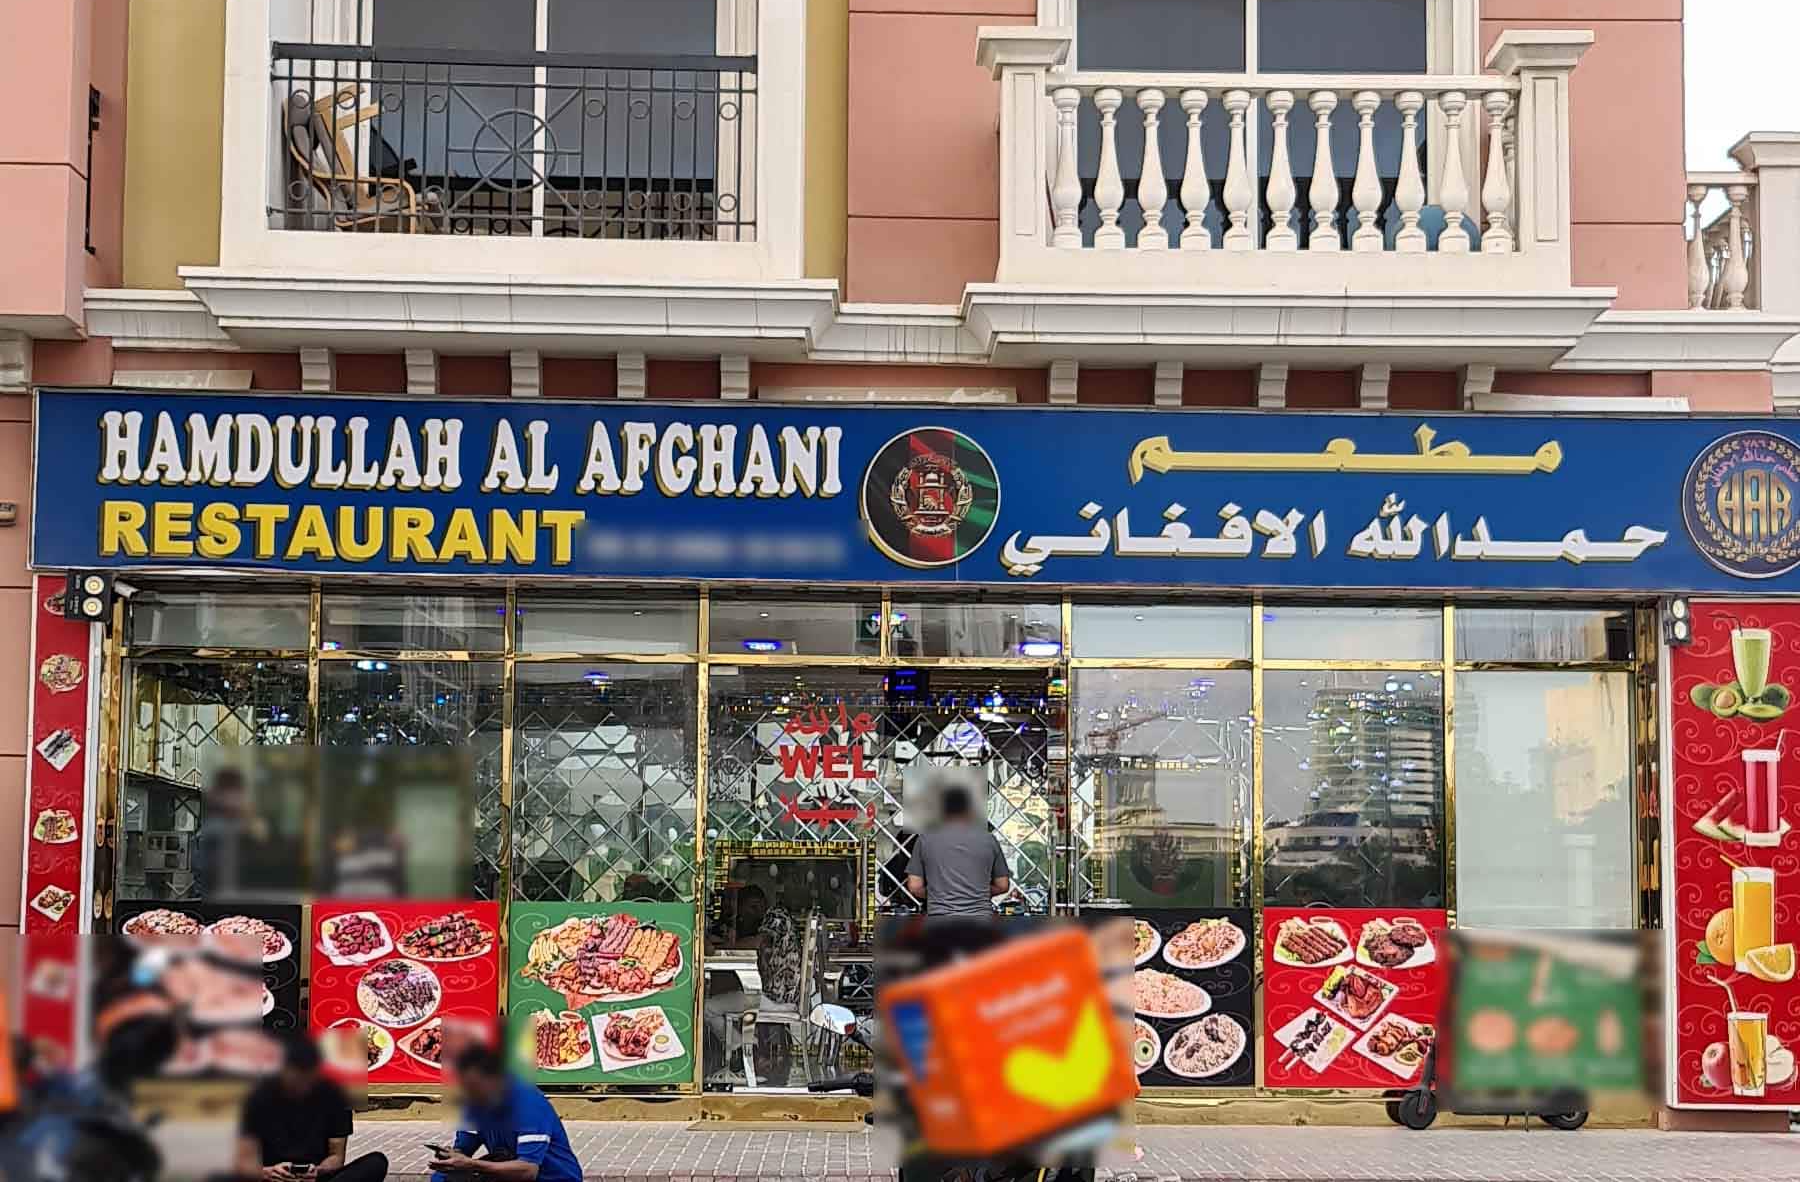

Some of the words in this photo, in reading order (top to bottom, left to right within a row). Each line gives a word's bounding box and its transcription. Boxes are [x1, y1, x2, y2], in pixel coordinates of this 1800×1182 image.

[98, 410, 464, 492] HAMDULLAH
[481, 418, 559, 495] AL
[576, 420, 843, 498] AFGHANI
[1128, 423, 1563, 485] مطعم
[101, 500, 586, 565] RESTAURANT
[1000, 501, 1327, 576] الافغاني
[780, 745, 877, 779] WEL
